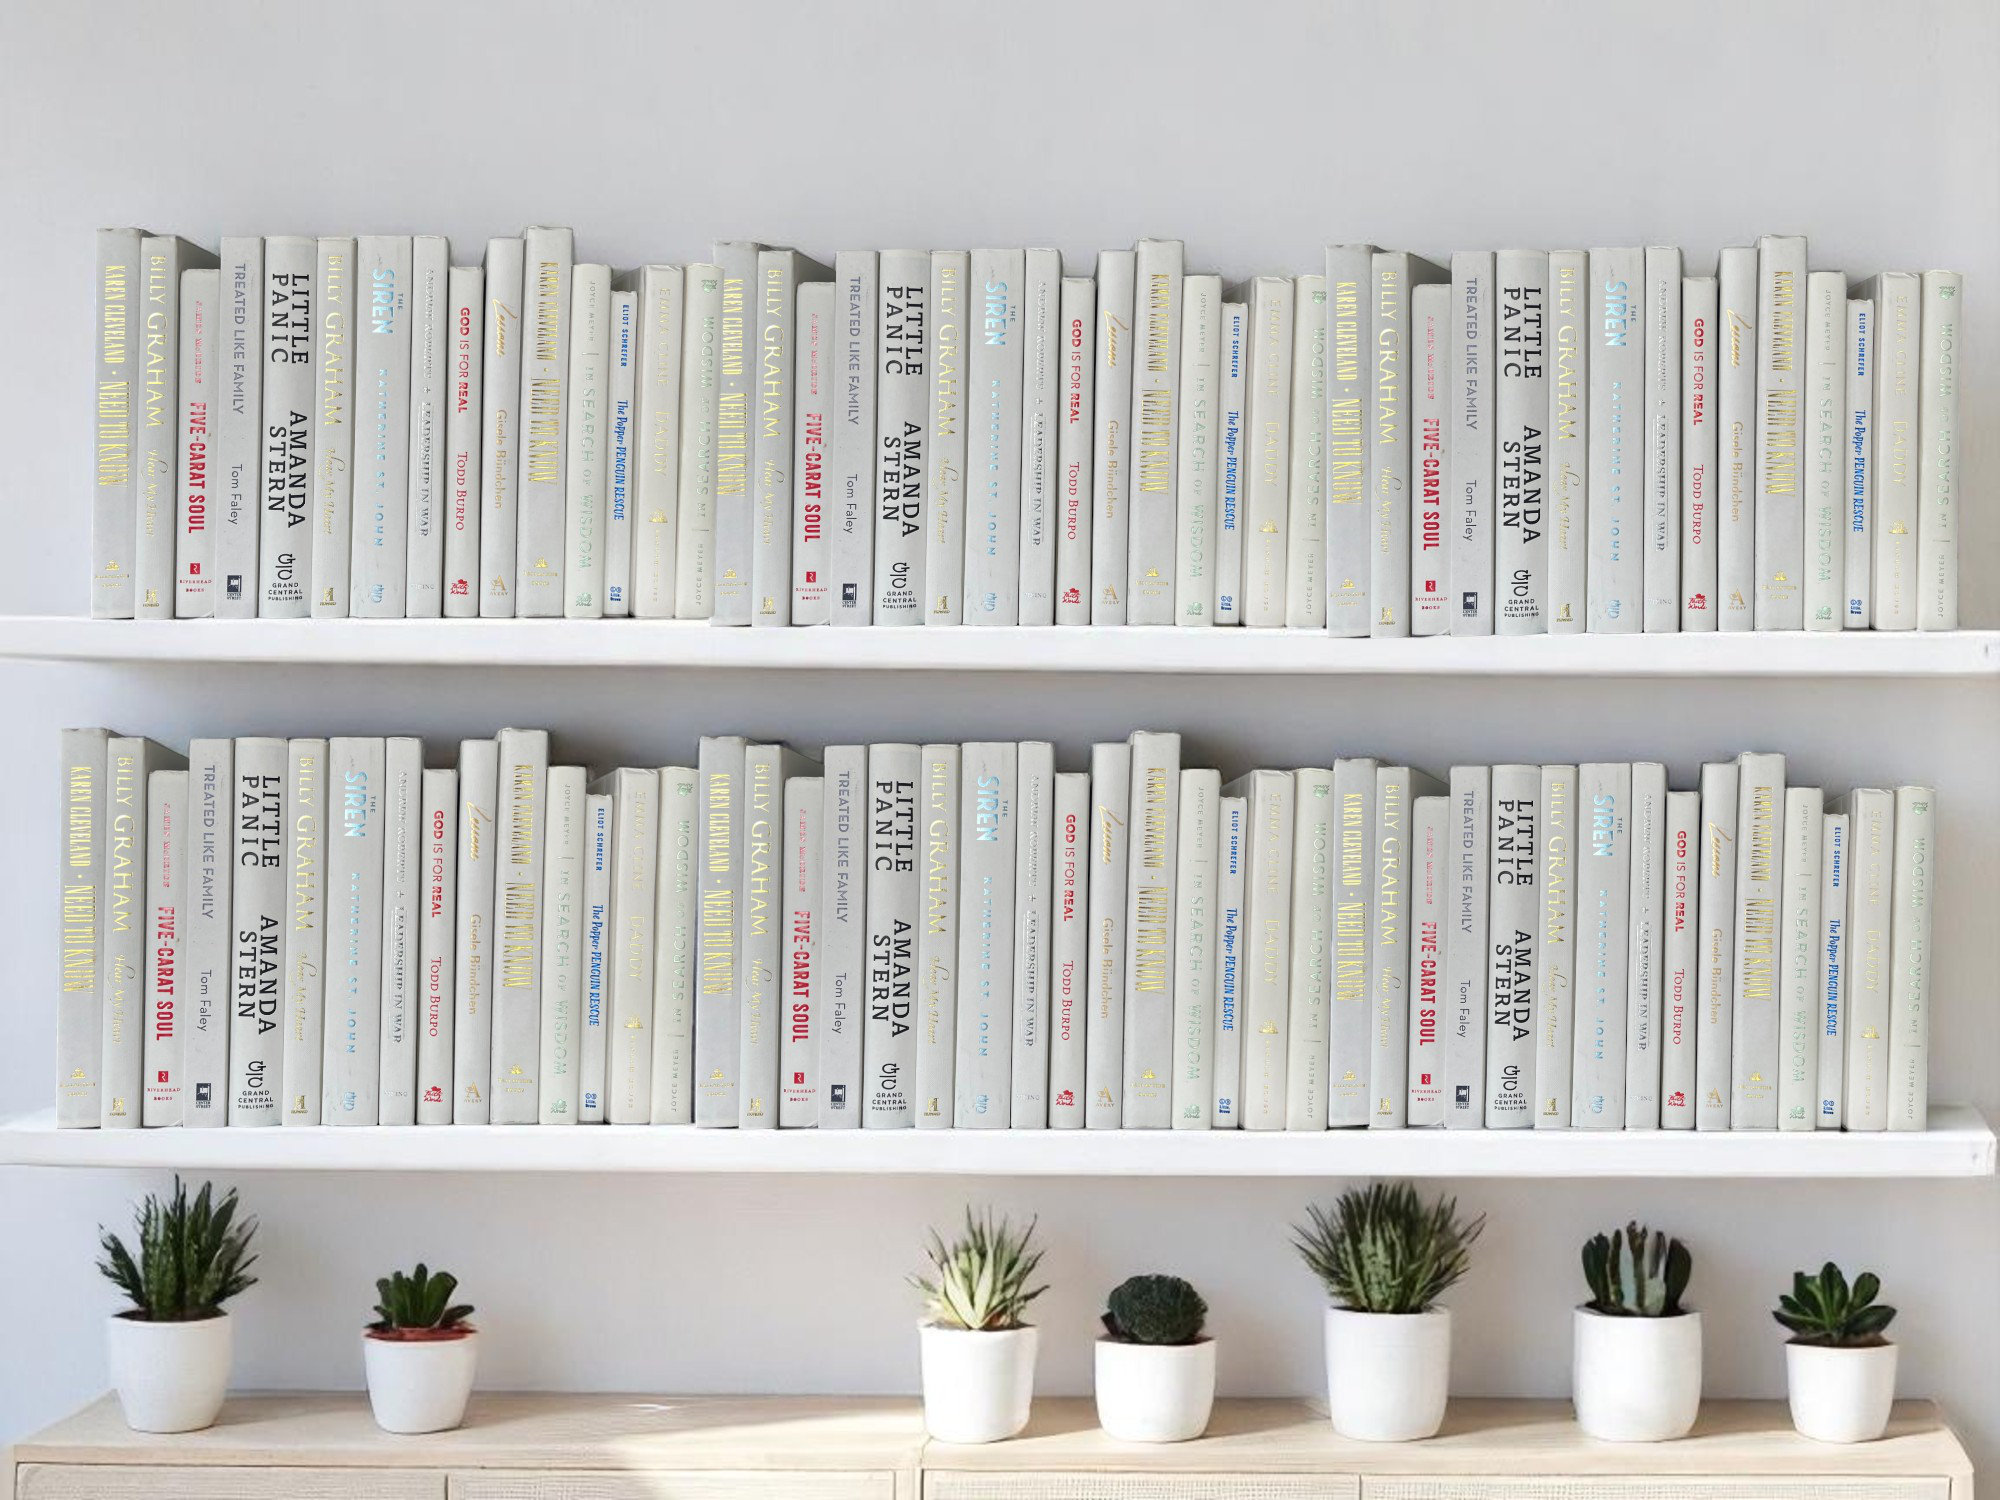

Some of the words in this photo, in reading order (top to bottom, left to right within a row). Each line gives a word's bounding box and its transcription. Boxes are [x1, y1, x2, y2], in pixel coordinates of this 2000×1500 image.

[149, 255, 166, 304] BILLY
[234, 263, 246, 324] TREATED
[1336, 281, 1357, 316] KAREN
[271, 273, 289, 362] PANIC
[291, 273, 309, 363] LITTLE
[371, 268, 395, 333] SIREN
[849, 275, 861, 336] TREATED
[984, 281, 1007, 345] SIREN
[1466, 277, 1477, 339] TREATED
[460, 307, 470, 335] GOD
[885, 286, 903, 373] PANIC
[905, 286, 923, 375] LITTLE
[1071, 319, 1082, 347] GOD
[1503, 286, 1521, 377] PANIC
[1524, 287, 1541, 378] LITTLE
[1693, 318, 1704, 347] GOD
[233, 329, 245, 359] LIKE
[459, 340, 469, 349] IS
[620, 328, 628, 366] SCHREFER
[848, 341, 860, 370] LIKE
[1071, 351, 1081, 361] IS
[1336, 321, 1357, 380] CLEVELAND
[1466, 344, 1477, 374] LIKE
[1693, 351, 1704, 361] IS
[146, 312, 166, 428] GRAHAM
[458, 354, 469, 377] FOR
[1070, 365, 1080, 389] FOR
[1693, 365, 1703, 389] FOR
[232, 364, 244, 414] FAMILY
[458, 382, 468, 413] REAL
[848, 375, 859, 425] FAMILY
[1070, 393, 1080, 423] REAL
[1466, 379, 1477, 429] FAMILY
[1228, 410, 1239, 425] The
[1331, 398, 1362, 435] NEED
[1693, 394, 1703, 425] REAL
[189, 402, 206, 489] FIVE-CARAT
[805, 413, 822, 498] FIVE-CARAT
[1224, 427, 1238, 455] Popper
[1332, 438, 1363, 456] TO
[231, 463, 242, 488] Tom
[268, 426, 286, 512] STERN
[288, 410, 307, 527] AMANDA
[456, 451, 468, 485] TODD
[882, 436, 901, 521] STERN
[902, 420, 921, 537] AMANDA
[1068, 461, 1079, 495] TODD
[1225, 456, 1237, 494] PENGUIN
[1423, 418, 1439, 505] FIVE-CARAT
[1692, 463, 1704, 498] TODD
[846, 473, 857, 498] Tom
[1332, 459, 1365, 504] KNOW
[1465, 479, 1477, 504] Tom
[1503, 441, 1520, 527] STERN
[1523, 425, 1541, 543] AMANDA
[188, 494, 205, 533] SOUL
[227, 493, 242, 524] Faley
[455, 489, 467, 530] BURPO
[804, 504, 821, 542] SOUL
[842, 503, 857, 533] Faley
[1067, 499, 1079, 540] BURPO
[1224, 496, 1236, 530] RESCUE
[1462, 509, 1477, 541] Faley
[1692, 502, 1703, 544] BURPO
[1423, 511, 1440, 550] SOUL
[203, 764, 215, 827] TREATED
[344, 770, 367, 837] SIREN
[838, 770, 850, 832] TREATED
[931, 761, 947, 811] BILLY
[241, 775, 259, 866] PANIC
[262, 775, 280, 867] LITTLE
[433, 810, 444, 839] GOD
[875, 780, 893, 870] PANIC
[895, 780, 913, 871] LITTLE
[976, 775, 999, 841] SIREN
[1384, 783, 1399, 829] BILLY
[1463, 790, 1474, 848] TREATED
[1592, 794, 1614, 856] SIREN
[202, 832, 214, 862] LIKE
[432, 843, 443, 853] IS
[1065, 814, 1076, 843] GOD
[1497, 799, 1514, 884] PANIC
[1516, 799, 1533, 885] LITTLE
[1676, 830, 1687, 858] GOD
[432, 857, 442, 882] FOR
[837, 837, 849, 867] LIKE
[1064, 847, 1075, 857] IS
[1462, 853, 1473, 881] LIKE
[1676, 861, 1686, 871] IS
[1832, 850, 1840, 886] SCHREFER
[201, 867, 214, 918] FAMILY
[928, 819, 948, 934] GRAHAM
[1064, 861, 1074, 885] FOR
[1380, 837, 1400, 946] GRAHAM
[1675, 875, 1685, 898] FOR
[431, 886, 442, 917] REAL
[592, 904, 603, 919] The
[836, 872, 848, 922] FAMILY
[1063, 890, 1074, 921] REAL
[1461, 885, 1472, 933] FAMILY
[589, 921, 603, 949] Popper
[1675, 902, 1685, 932] REAL
[157, 906, 174, 995] FIVE-CARAT
[793, 911, 810, 998] FIVE-CARAT
[1101, 917, 1114, 960] Gisele
[200, 969, 212, 994] Tom
[238, 930, 257, 1018] STERN
[258, 914, 278, 1034] AMANDA
[430, 956, 441, 991] TODD
[589, 951, 602, 990] PENGUIN
[872, 934, 890, 1021] STERN
[891, 918, 911, 1037] AMANDA
[1062, 960, 1073, 995] TODD
[1420, 922, 1437, 1003] FIVE-CARAT
[835, 972, 846, 997] Tom
[1459, 979, 1470, 1003] Tom
[1494, 944, 1512, 1026] STERN
[1513, 929, 1531, 1041] AMANDA
[1673, 968, 1684, 1001] TODD
[156, 1000, 174, 1040] SOUL
[196, 999, 211, 1031] Faley
[429, 995, 441, 1036] BURPO
[588, 991, 600, 1026] RESCUE
[792, 1003, 809, 1042] SOUL
[831, 1002, 846, 1034] Faley
[1061, 999, 1073, 1040] BURPO
[1419, 1009, 1436, 1045] SOUL
[1456, 1008, 1470, 1037] Faley
[1672, 1005, 1684, 1044] BURPO
